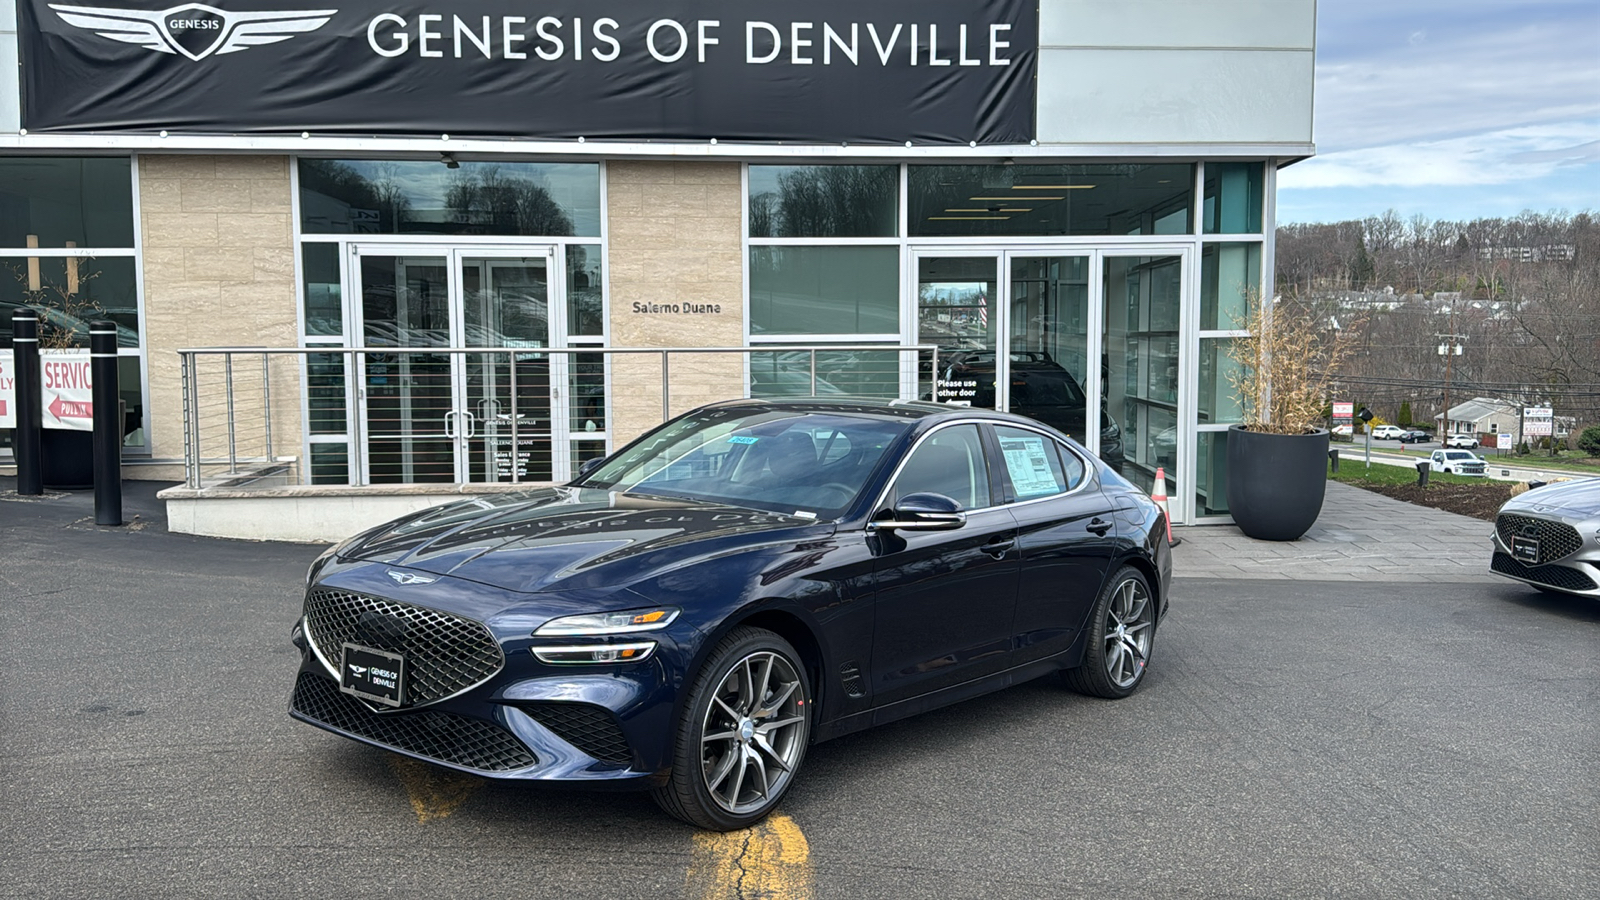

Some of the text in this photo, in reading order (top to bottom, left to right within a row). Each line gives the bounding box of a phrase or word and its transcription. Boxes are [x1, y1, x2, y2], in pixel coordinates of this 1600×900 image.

[169, 19, 219, 30] GENESIS
[367, 12, 1012, 67] GENESIS OF DENVILLE
[633, 301, 721, 314] Salerno Duane
[45, 361, 92, 389] SERVIC
[937, 379, 962, 388] Please
[938, 389, 976, 397] other door
[61, 402, 78, 415] PULL
[371, 666, 390, 678] GENESIS
[390, 672, 398, 680] OF
[373, 677, 396, 689] DENVILLE
